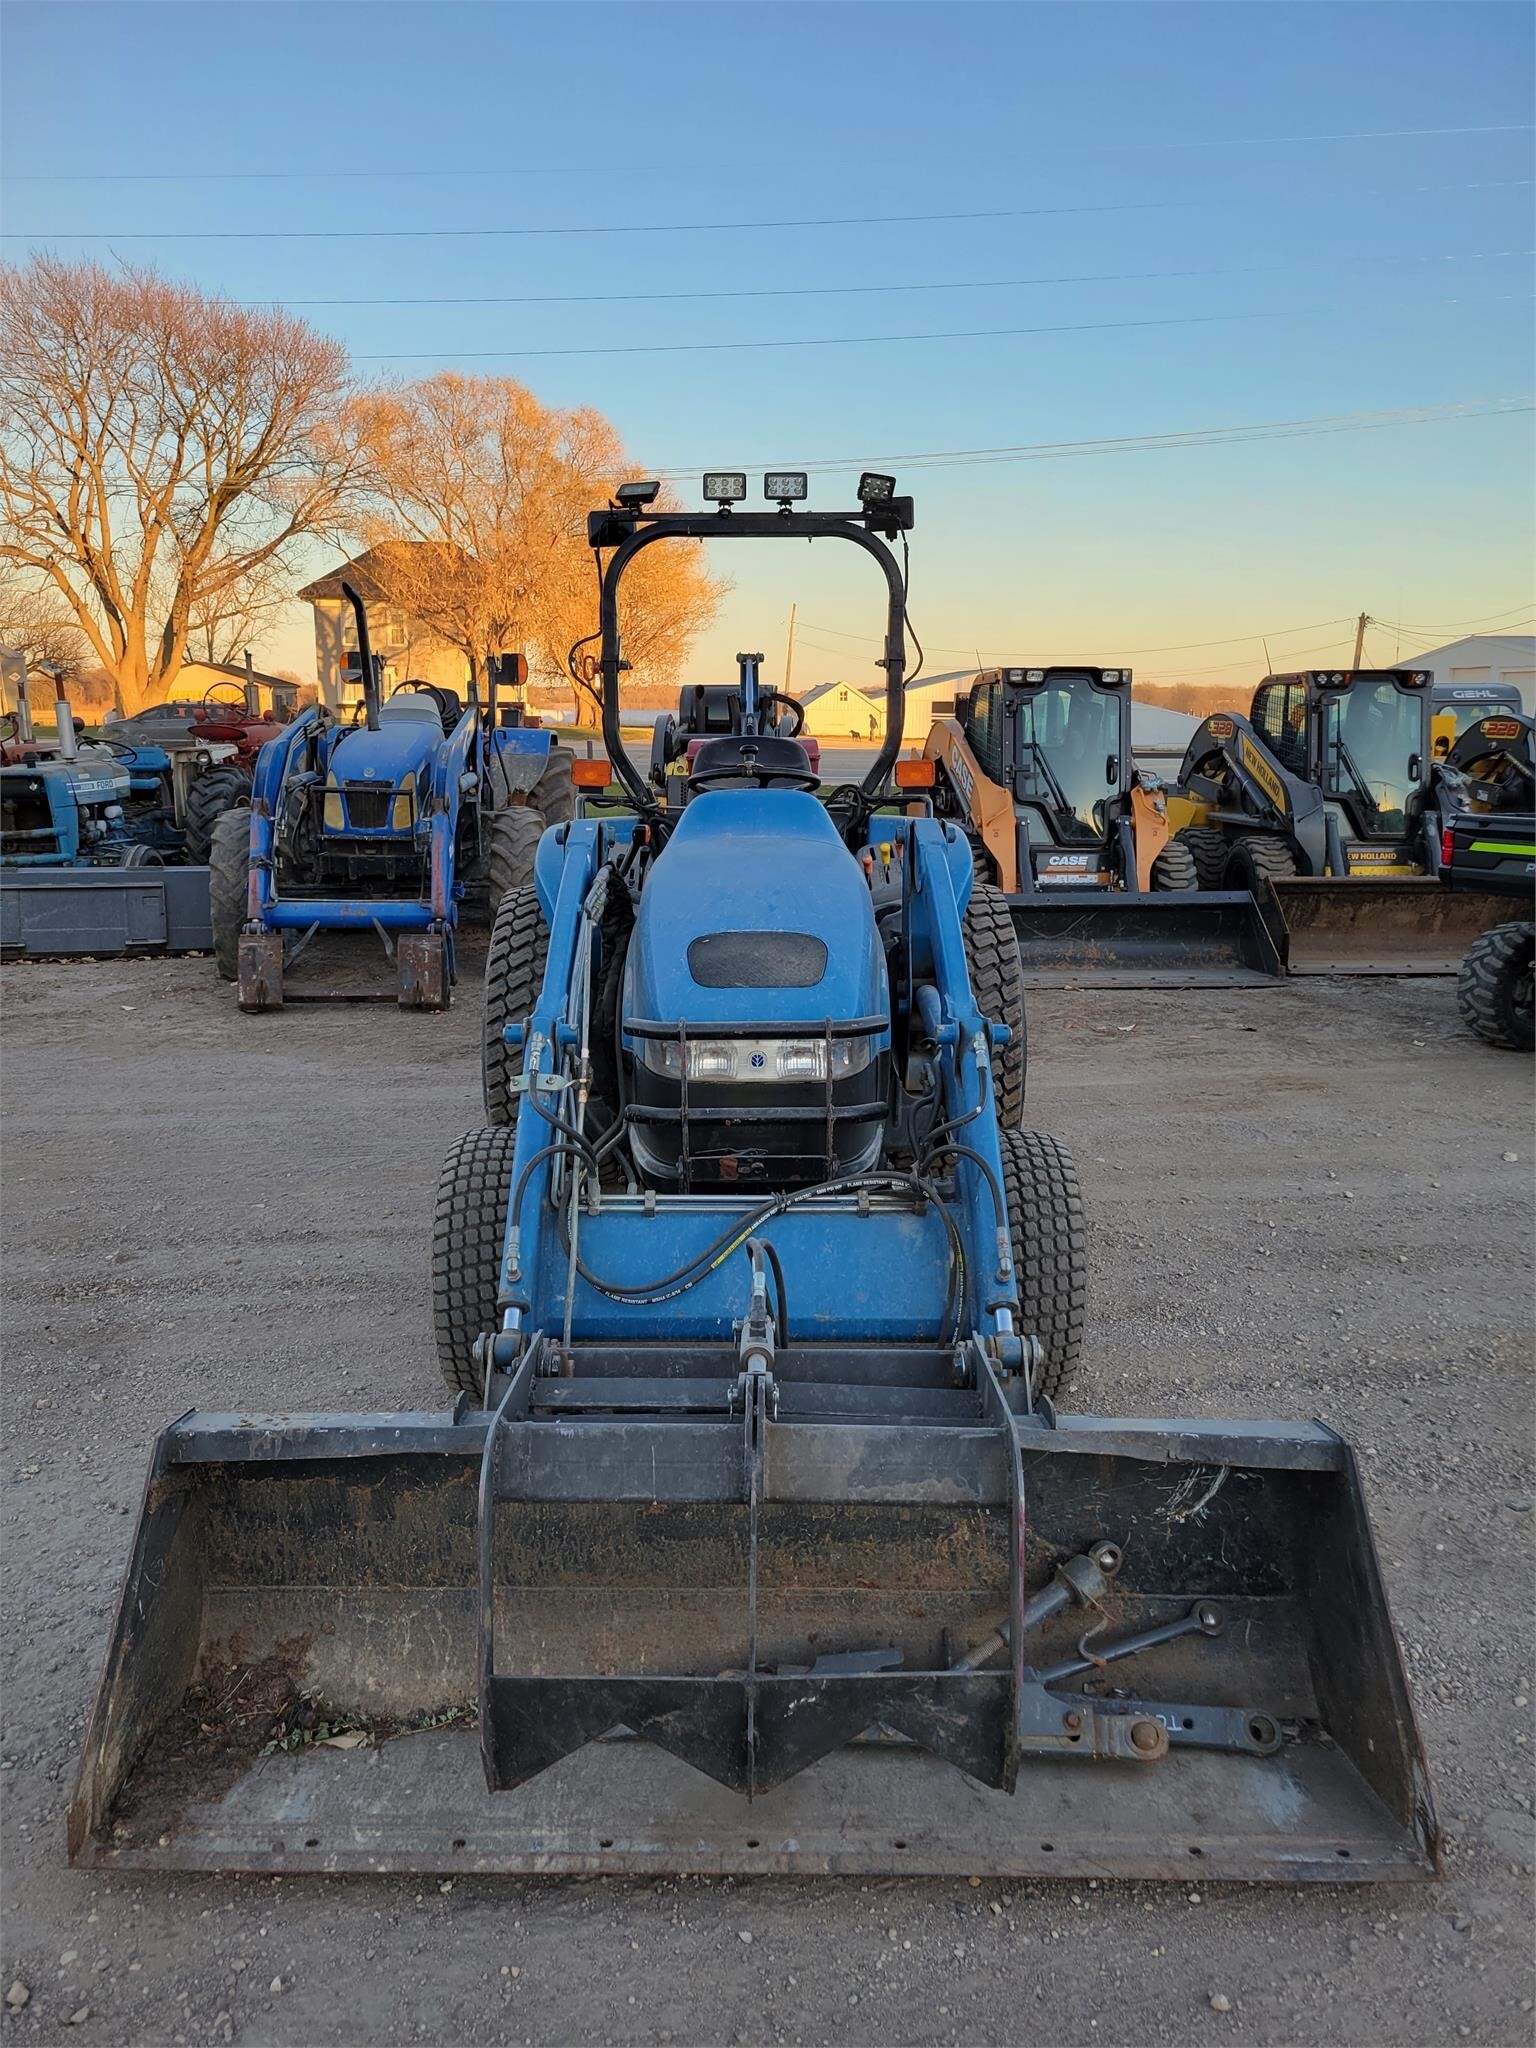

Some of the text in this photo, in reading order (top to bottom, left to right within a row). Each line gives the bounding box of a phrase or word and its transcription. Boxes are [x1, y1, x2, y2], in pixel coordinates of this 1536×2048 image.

[1452, 690, 1498, 698] GEHL
[1480, 721, 1520, 738] L228
[951, 744, 974, 801] CASE
[96, 780, 114, 789] FORD
[1257, 764, 1280, 797] HOLLAND
[1049, 856, 1088, 866] CASE
[1360, 852, 1397, 860] HOLLAND
